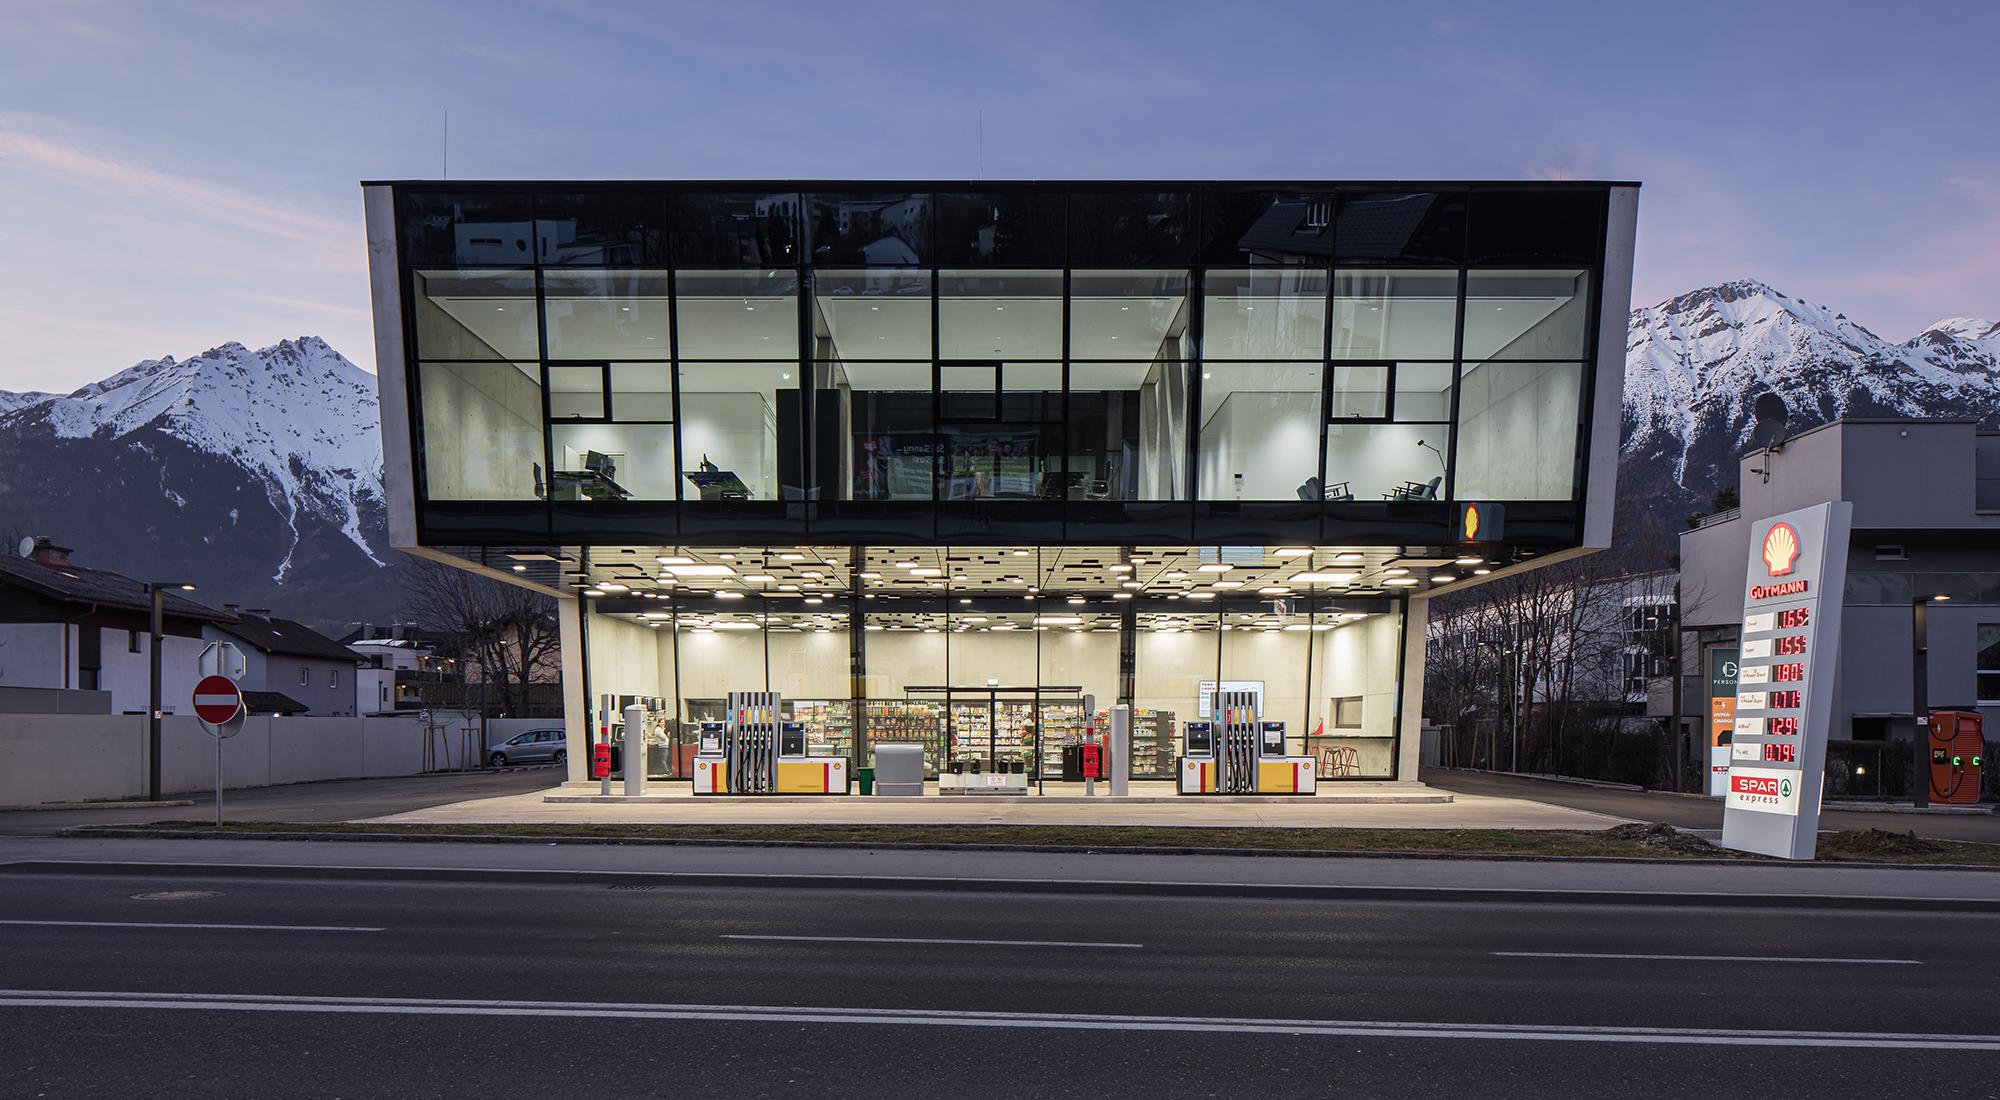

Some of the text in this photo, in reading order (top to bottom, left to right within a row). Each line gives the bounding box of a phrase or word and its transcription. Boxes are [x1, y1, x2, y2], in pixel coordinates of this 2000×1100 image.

[1750, 581, 1806, 599] GUTMANN
[1740, 779, 1777, 793] SPAR
[1740, 795, 1778, 804] express
